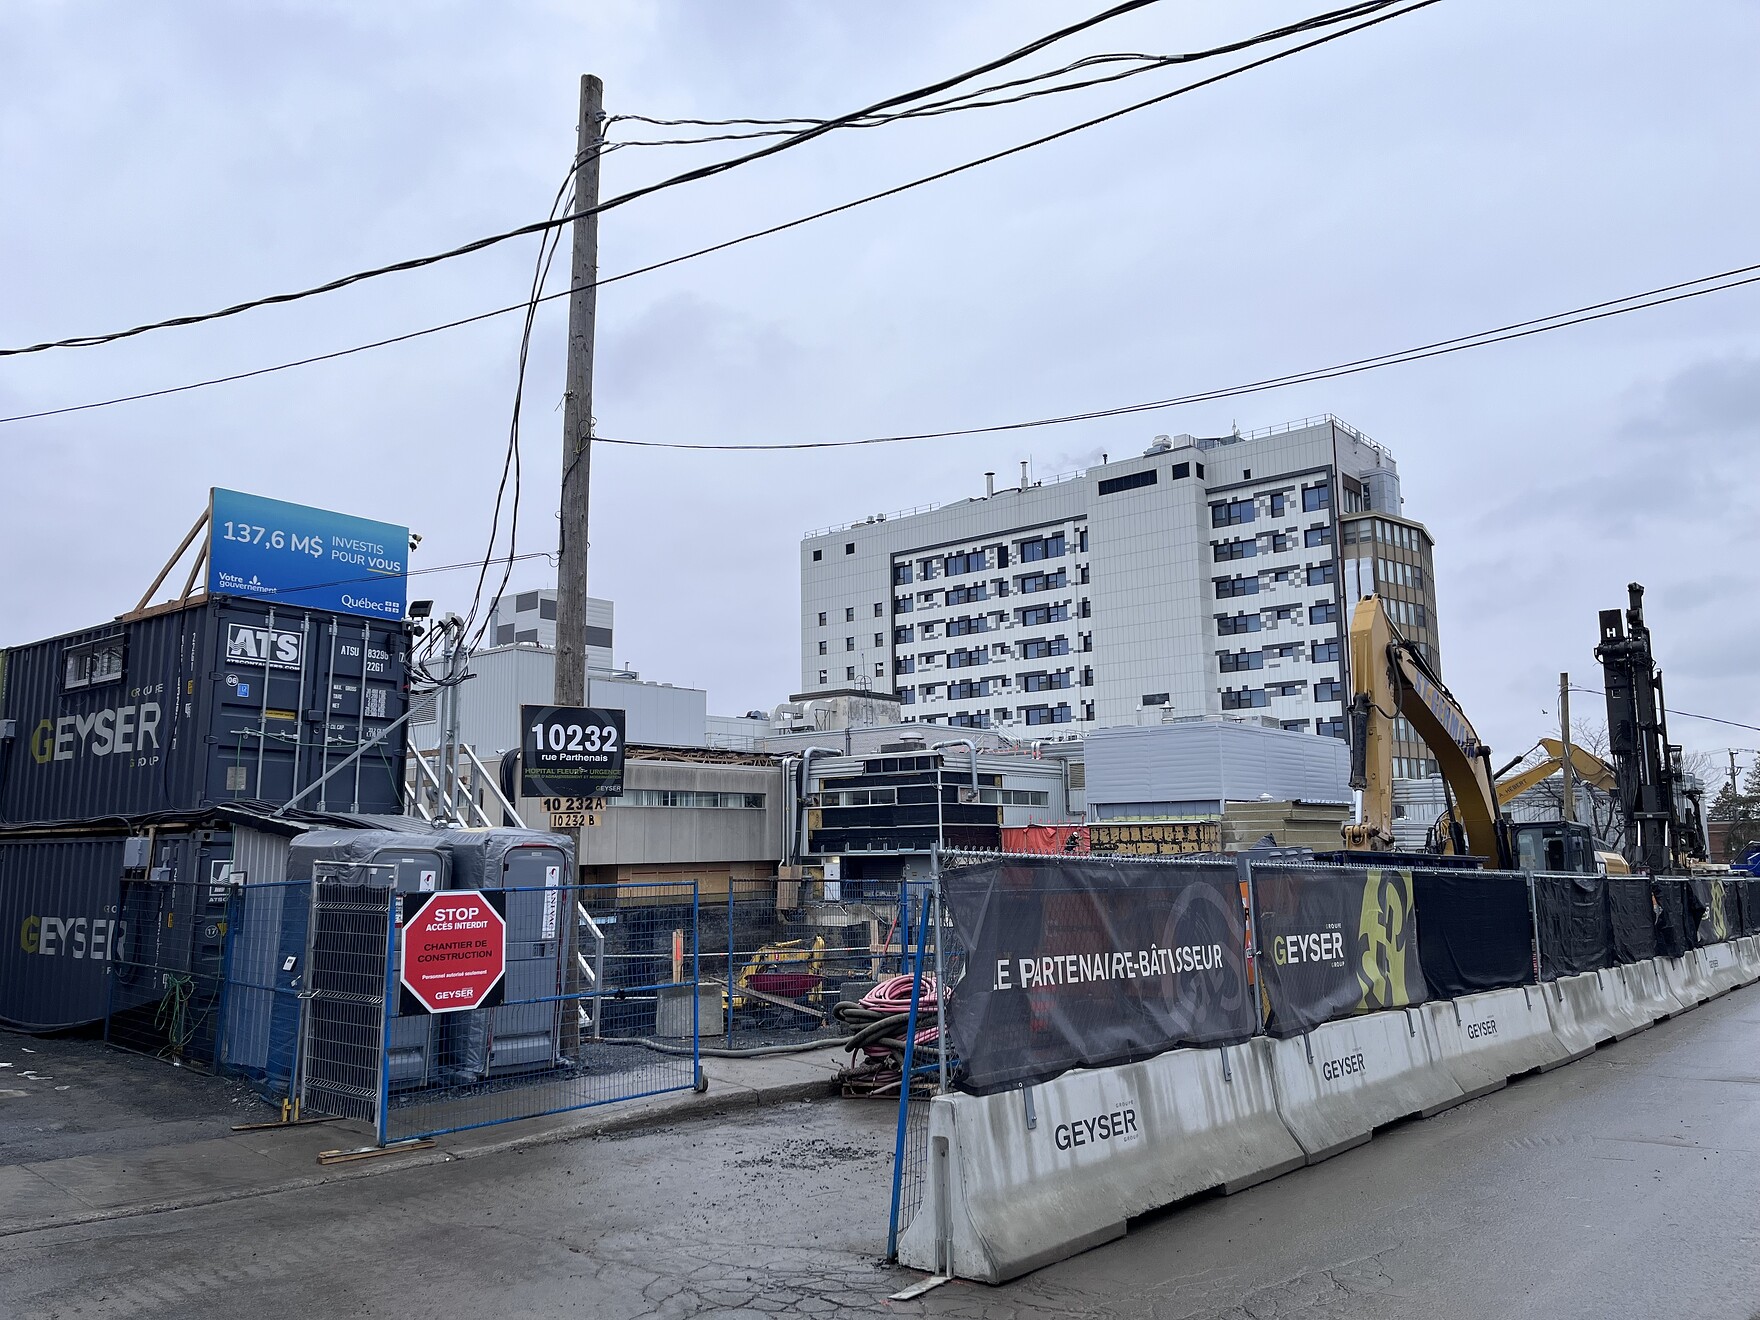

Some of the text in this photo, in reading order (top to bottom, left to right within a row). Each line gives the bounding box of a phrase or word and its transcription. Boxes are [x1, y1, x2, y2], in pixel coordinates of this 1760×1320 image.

[223, 521, 323, 558] 137,6 M$
[332, 536, 384, 555] INVESTIS
[331, 550, 401, 572] POUR VOUS
[219, 571, 244, 584] Votre
[219, 580, 277, 595] gouvernement
[341, 595, 384, 612] Québec
[231, 629, 298, 662] ATS
[340, 645, 360, 657] ATSU
[226, 658, 301, 671] ATSCONTAIERS.COM
[366, 661, 384, 672] 22G1
[31, 702, 161, 764] GEYSER
[531, 723, 618, 752] 10232
[560, 753, 608, 762] Parthenais
[544, 798, 560, 811] 10
[565, 814, 585, 826] 232
[589, 814, 594, 825] B
[435, 908, 479, 921] STOP
[426, 921, 488, 931] ACCÈS INTERDIT
[424, 942, 472, 951] CHANTIER
[1274, 932, 1344, 965] GEYSER
[418, 950, 492, 962] CONSTRUCTION
[1018, 943, 1223, 989] PARTENAIRE-BÂTISSEUR
[435, 990, 473, 1000] GEYSER
[1467, 1020, 1497, 1039] GEYSER
[1323, 1053, 1365, 1081] GEYSER
[1055, 1109, 1137, 1150] GEYSER
